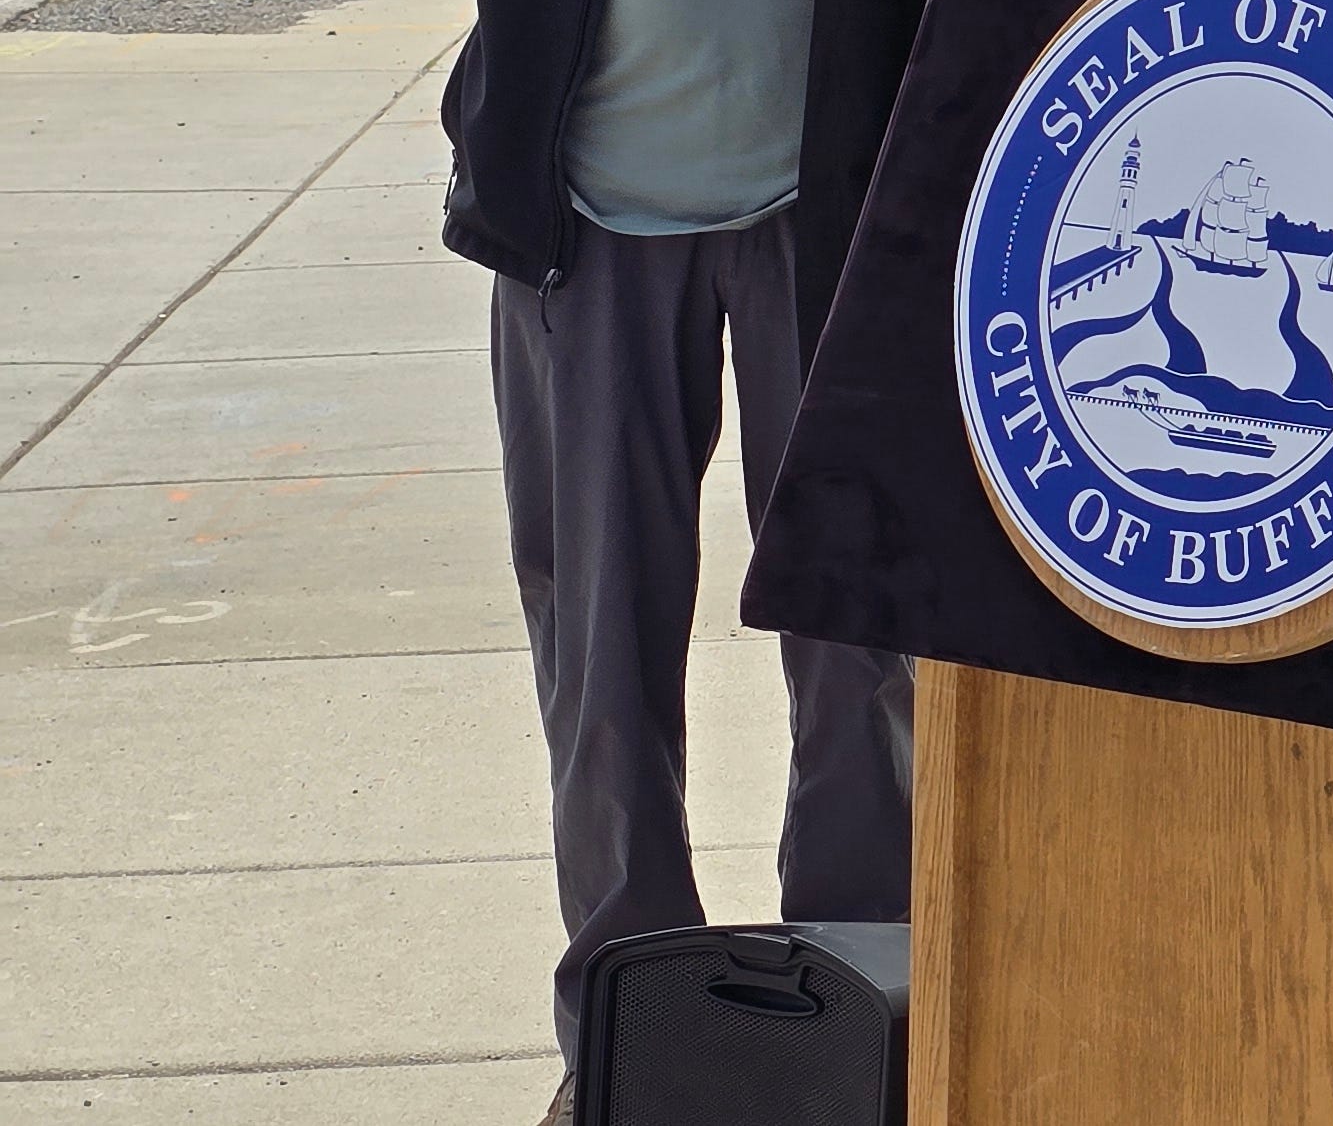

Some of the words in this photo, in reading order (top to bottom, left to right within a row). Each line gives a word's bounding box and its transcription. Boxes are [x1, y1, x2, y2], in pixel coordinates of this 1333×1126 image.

[1042, 2, 1204, 156] SEAL
[985, 311, 1073, 490] CITY
[1068, 488, 1151, 566] OF
